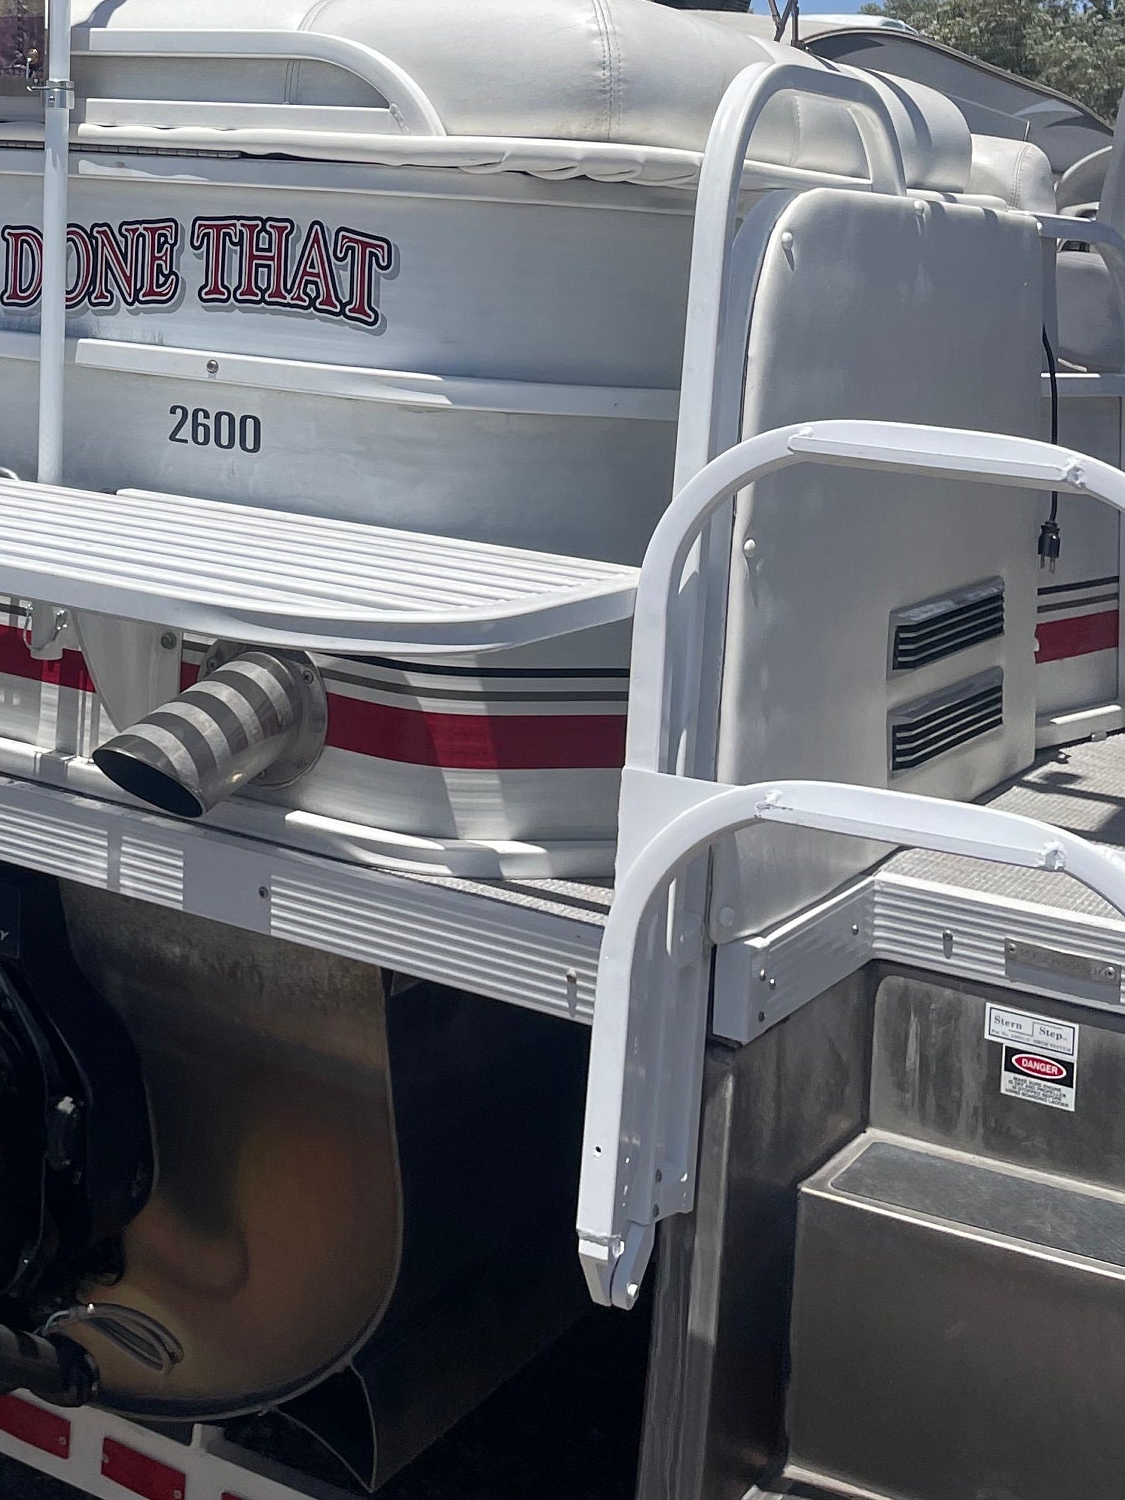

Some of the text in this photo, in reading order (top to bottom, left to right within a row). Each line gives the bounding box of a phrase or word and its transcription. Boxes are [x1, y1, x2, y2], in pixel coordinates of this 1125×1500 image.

[1, 219, 178, 309] DONE
[191, 215, 393, 327] THAT
[169, 405, 261, 454] 2600
[994, 1015, 1022, 1030] Stern
[1039, 1027, 1063, 1041] Step
[1021, 1058, 1059, 1076] DANGER
